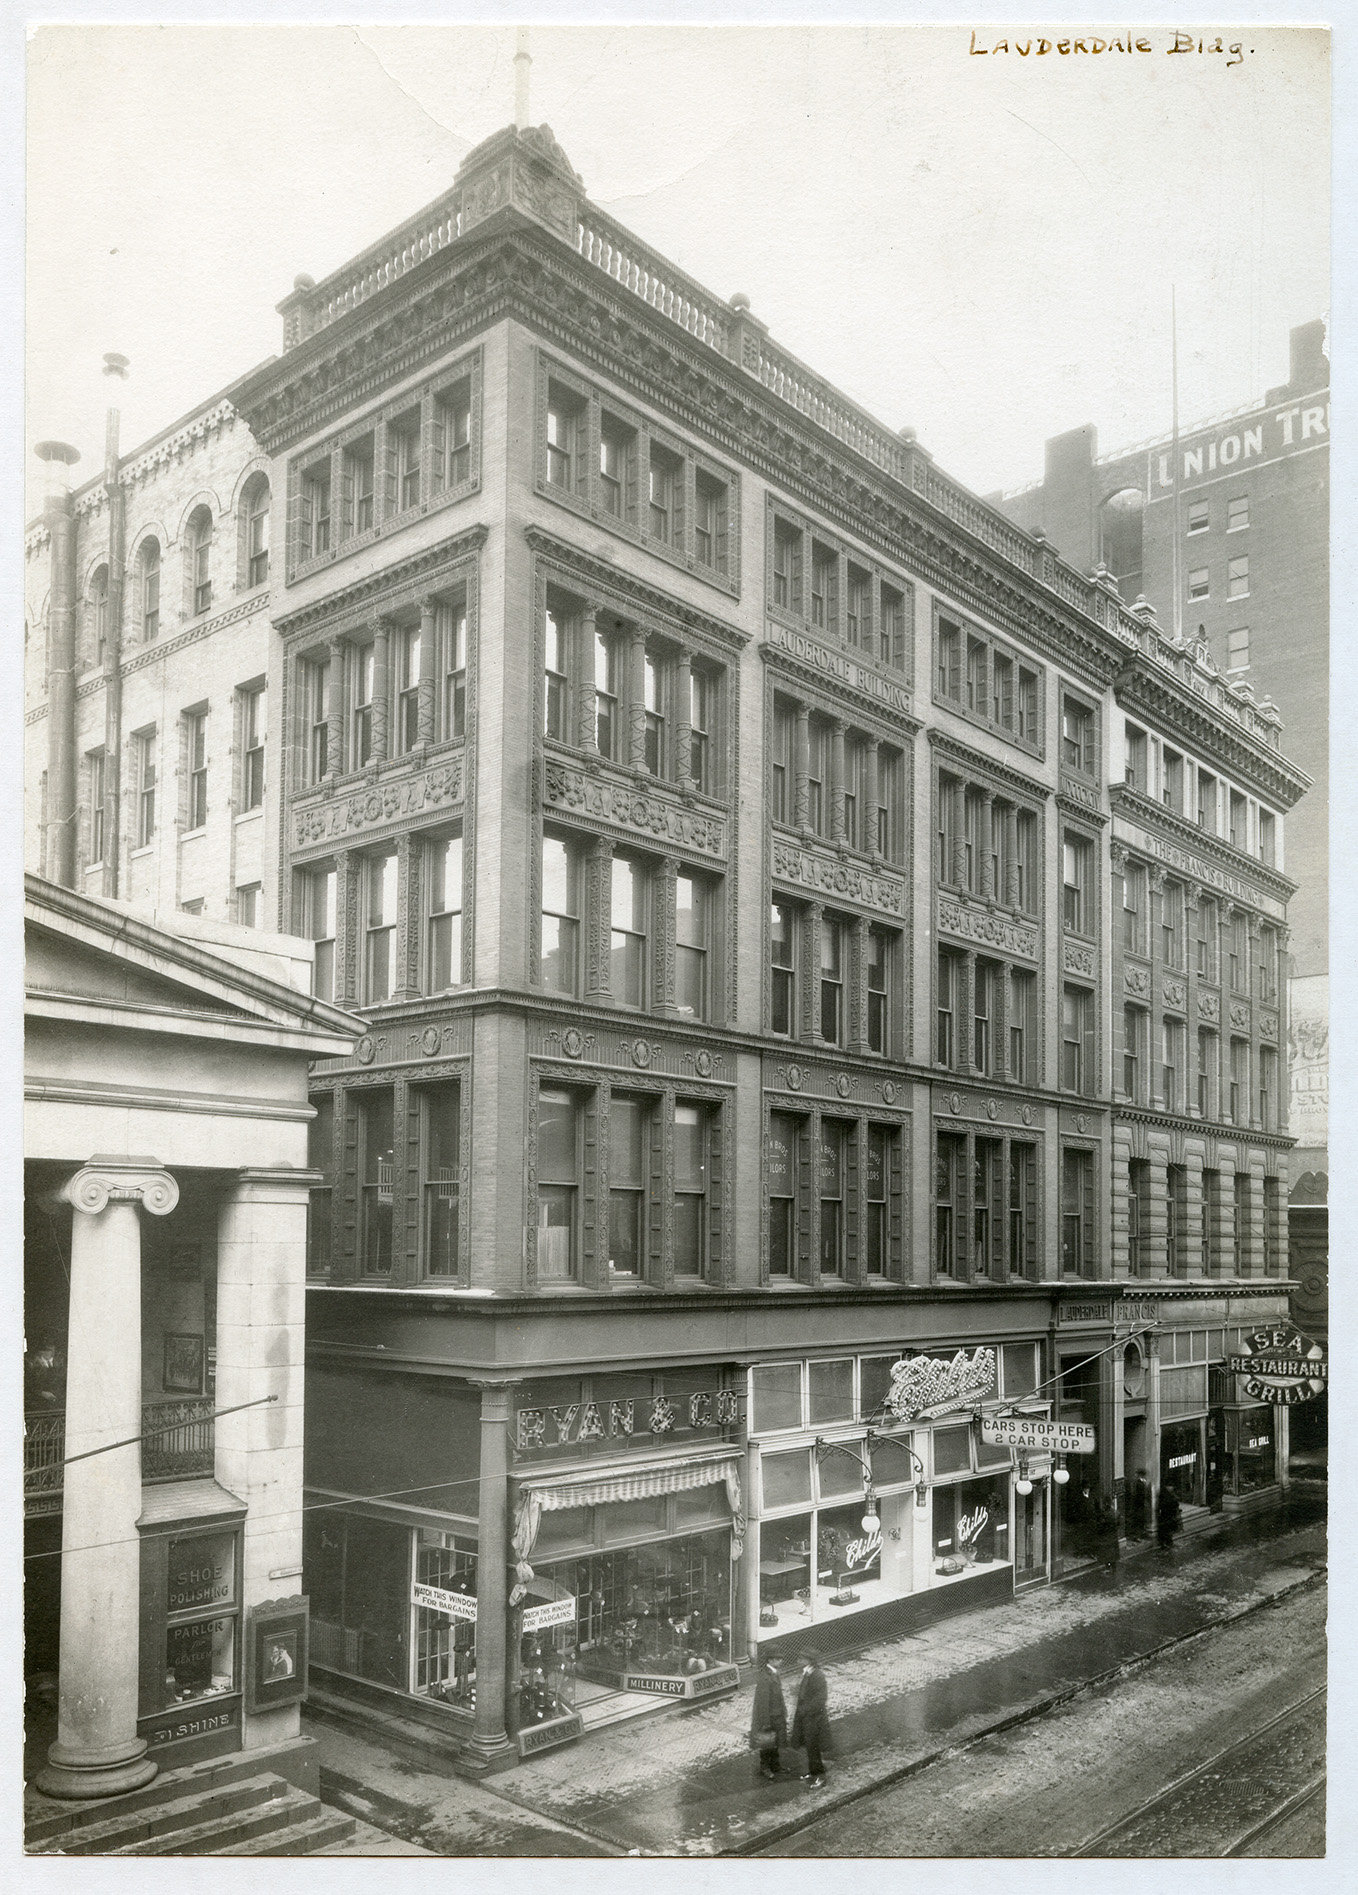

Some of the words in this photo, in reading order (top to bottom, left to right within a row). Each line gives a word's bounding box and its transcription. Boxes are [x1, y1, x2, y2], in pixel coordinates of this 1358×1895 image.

[1166, 29, 1255, 68] Bldg.
[1275, 402, 1330, 447] TR
[769, 622, 850, 683] LAUDERDALE
[856, 668, 911, 713] BUILDING
[1153, 838, 1172, 862] THE
[1180, 851, 1216, 884] FRANCIS
[1222, 874, 1259, 905] BUILDING
[769, 1163, 787, 1174] ILORS
[1060, 1305, 1108, 1321] LAUDERDALE
[1116, 1304, 1156, 1320] FRANCIS
[1254, 1330, 1303, 1354] SEA
[1230, 1356, 1328, 1378] RESTAURANT
[1246, 1380, 1312, 1404] GRILL
[518, 1400, 634, 1449] RYAN
[649, 1396, 676, 1433] &
[689, 1391, 747, 1427] CO.
[983, 1420, 1016, 1432] CARS
[1021, 1423, 1054, 1435] STOP
[995, 1434, 1003, 1443] 2
[1008, 1435, 1036, 1446] CAR
[1168, 1452, 1197, 1469] RESTAURANT
[956, 1506, 989, 1544] Childs
[845, 1529, 884, 1570] Childs
[177, 1566, 223, 1586] SHOE
[169, 1585, 229, 1605] POLISHING
[448, 1595, 478, 1609] WINDOW
[422, 1597, 438, 1607] FOR
[438, 1602, 476, 1618] BARGAINS
[522, 1610, 540, 1620] WATCH
[540, 1607, 551, 1615] THIS
[551, 1602, 573, 1613] WINDOW
[522, 1619, 536, 1628] FOR
[538, 1609, 572, 1625] BARGAINS
[174, 1620, 224, 1640] PARLOR
[174, 1648, 222, 1666] GENTLEMEN
[630, 1679, 684, 1693] MILLINERY
[176, 1714, 230, 1736] SHINE
[525, 1730, 552, 1748] RYAN
